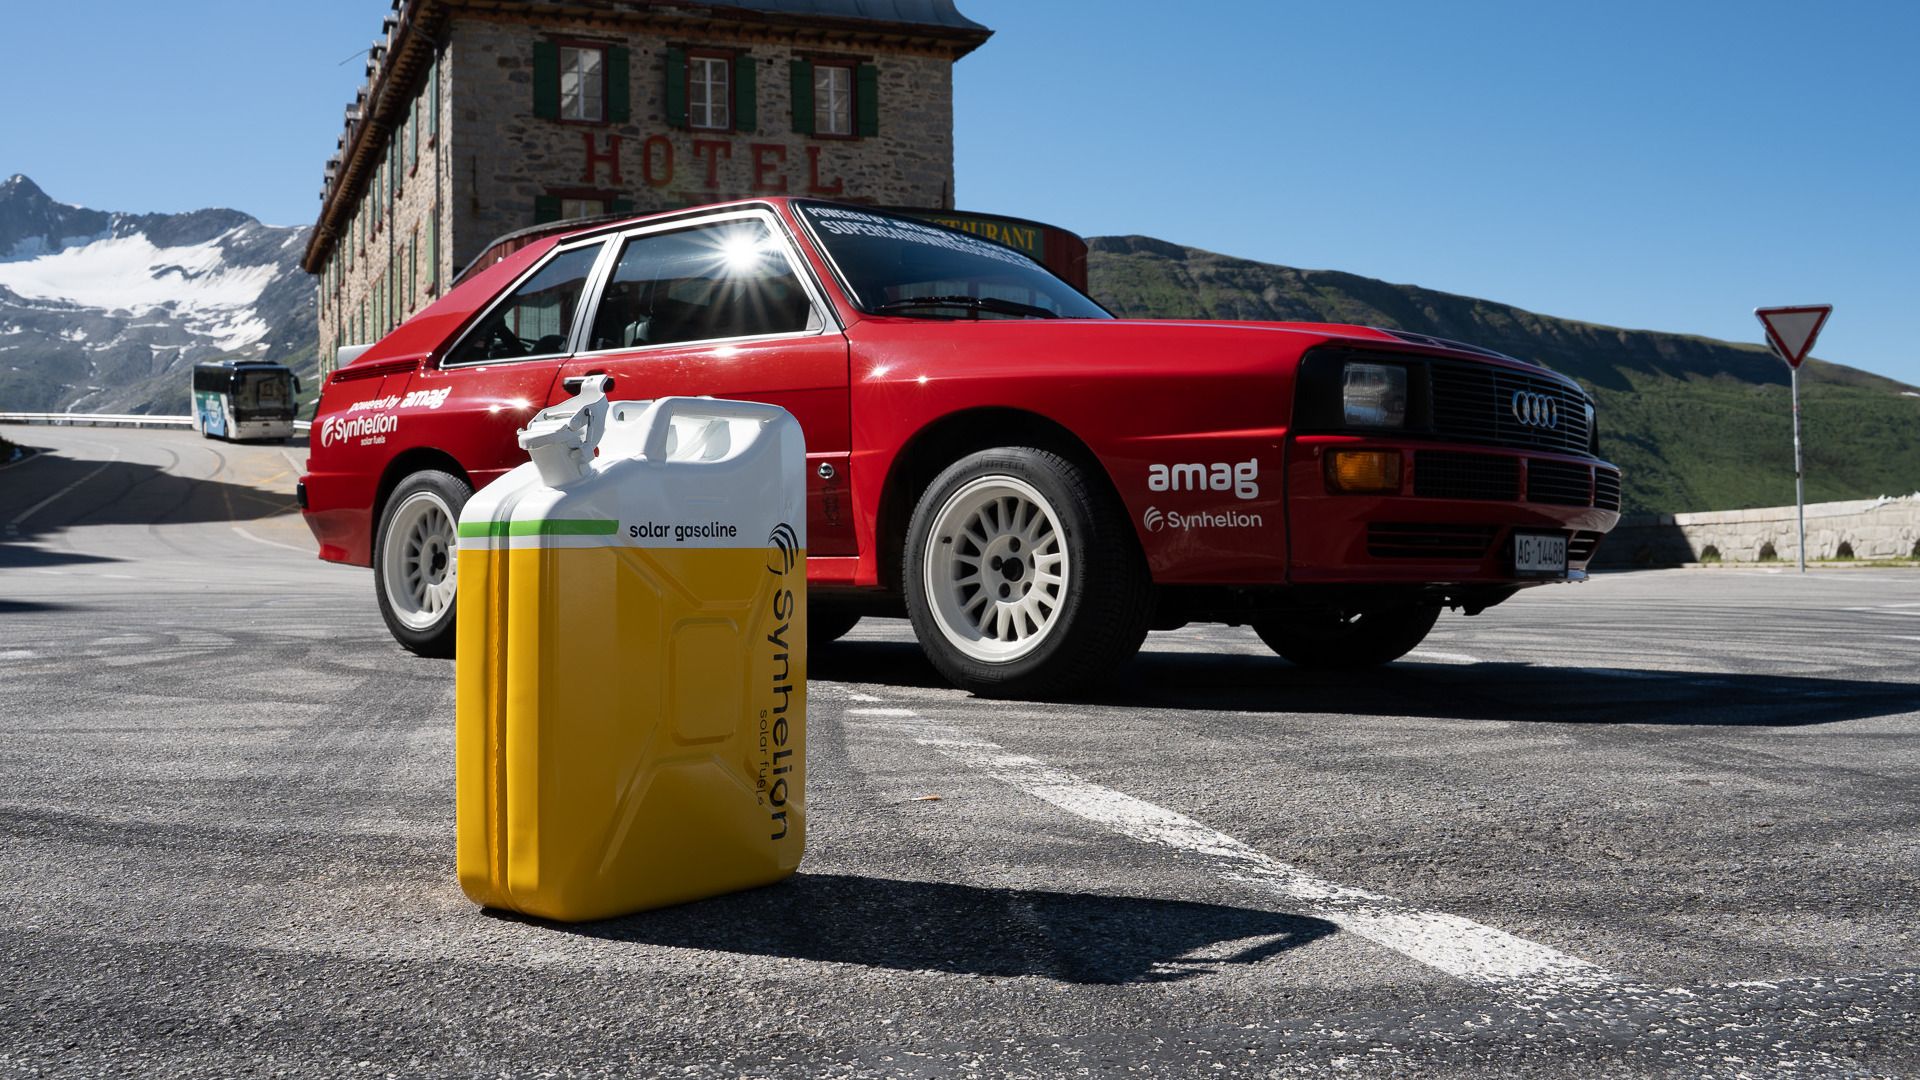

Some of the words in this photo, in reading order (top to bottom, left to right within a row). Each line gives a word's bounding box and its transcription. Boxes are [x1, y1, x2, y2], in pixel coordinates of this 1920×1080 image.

[581, 132, 843, 194] HOTEL
[806, 207, 872, 222] POWERED
[868, 214, 889, 226] BY
[346, 395, 391, 414] powered
[386, 394, 401, 410] by
[400, 386, 452, 409] amag
[335, 413, 398, 444] Synhelion
[361, 437, 373, 446] solar
[1148, 458, 1259, 500] amag
[629, 521, 670, 538] solar
[675, 521, 737, 542] gasoline
[1167, 511, 1263, 532] Synhelion
[1517, 539, 1530, 565] AG
[767, 588, 795, 840] Synhelion
[759, 709, 768, 755] solar
[756, 760, 769, 806] fuels
